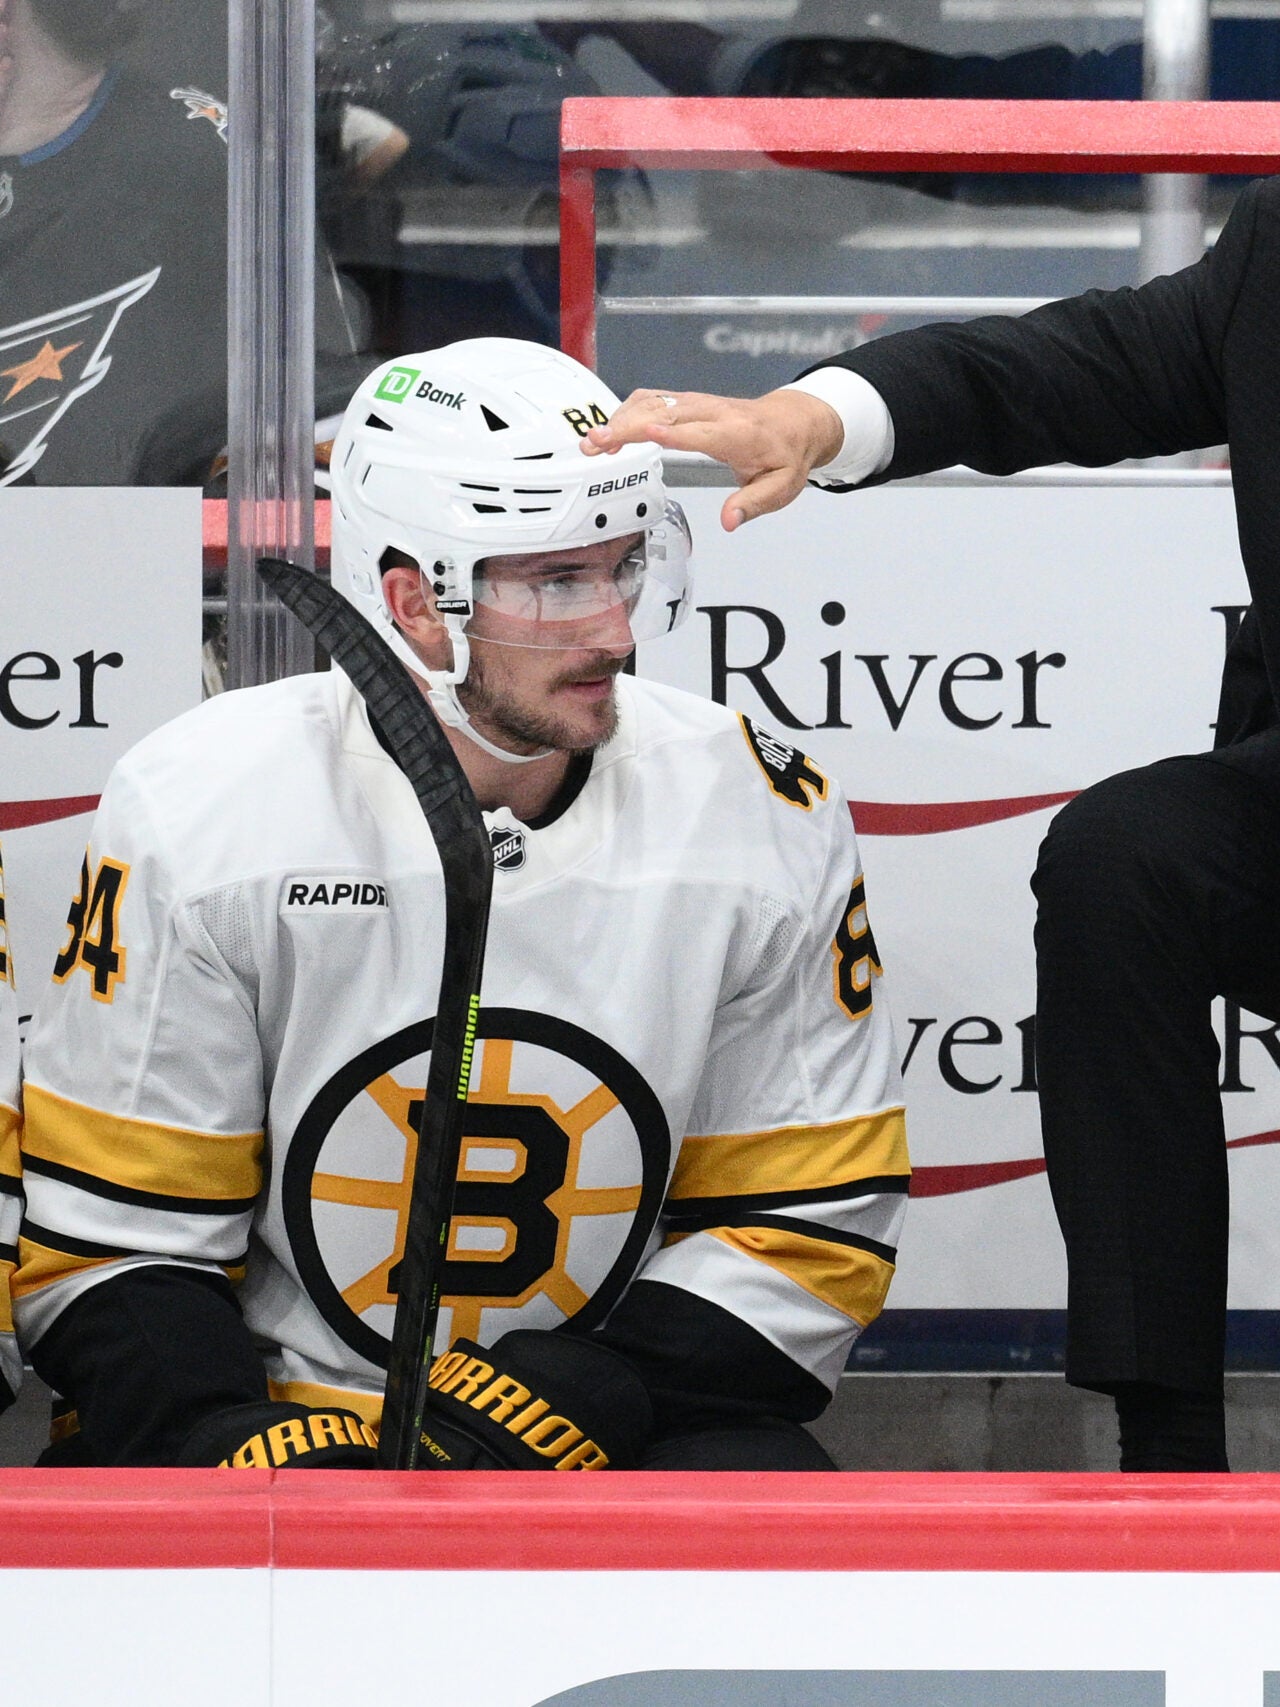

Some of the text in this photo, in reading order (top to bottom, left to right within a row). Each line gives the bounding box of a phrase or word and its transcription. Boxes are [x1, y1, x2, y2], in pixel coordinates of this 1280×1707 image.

[415, 380, 468, 411] Bank
[696, 601, 1067, 732] River
[491, 837, 522, 863] NHL
[457, 993, 480, 1101] WARRIOR
